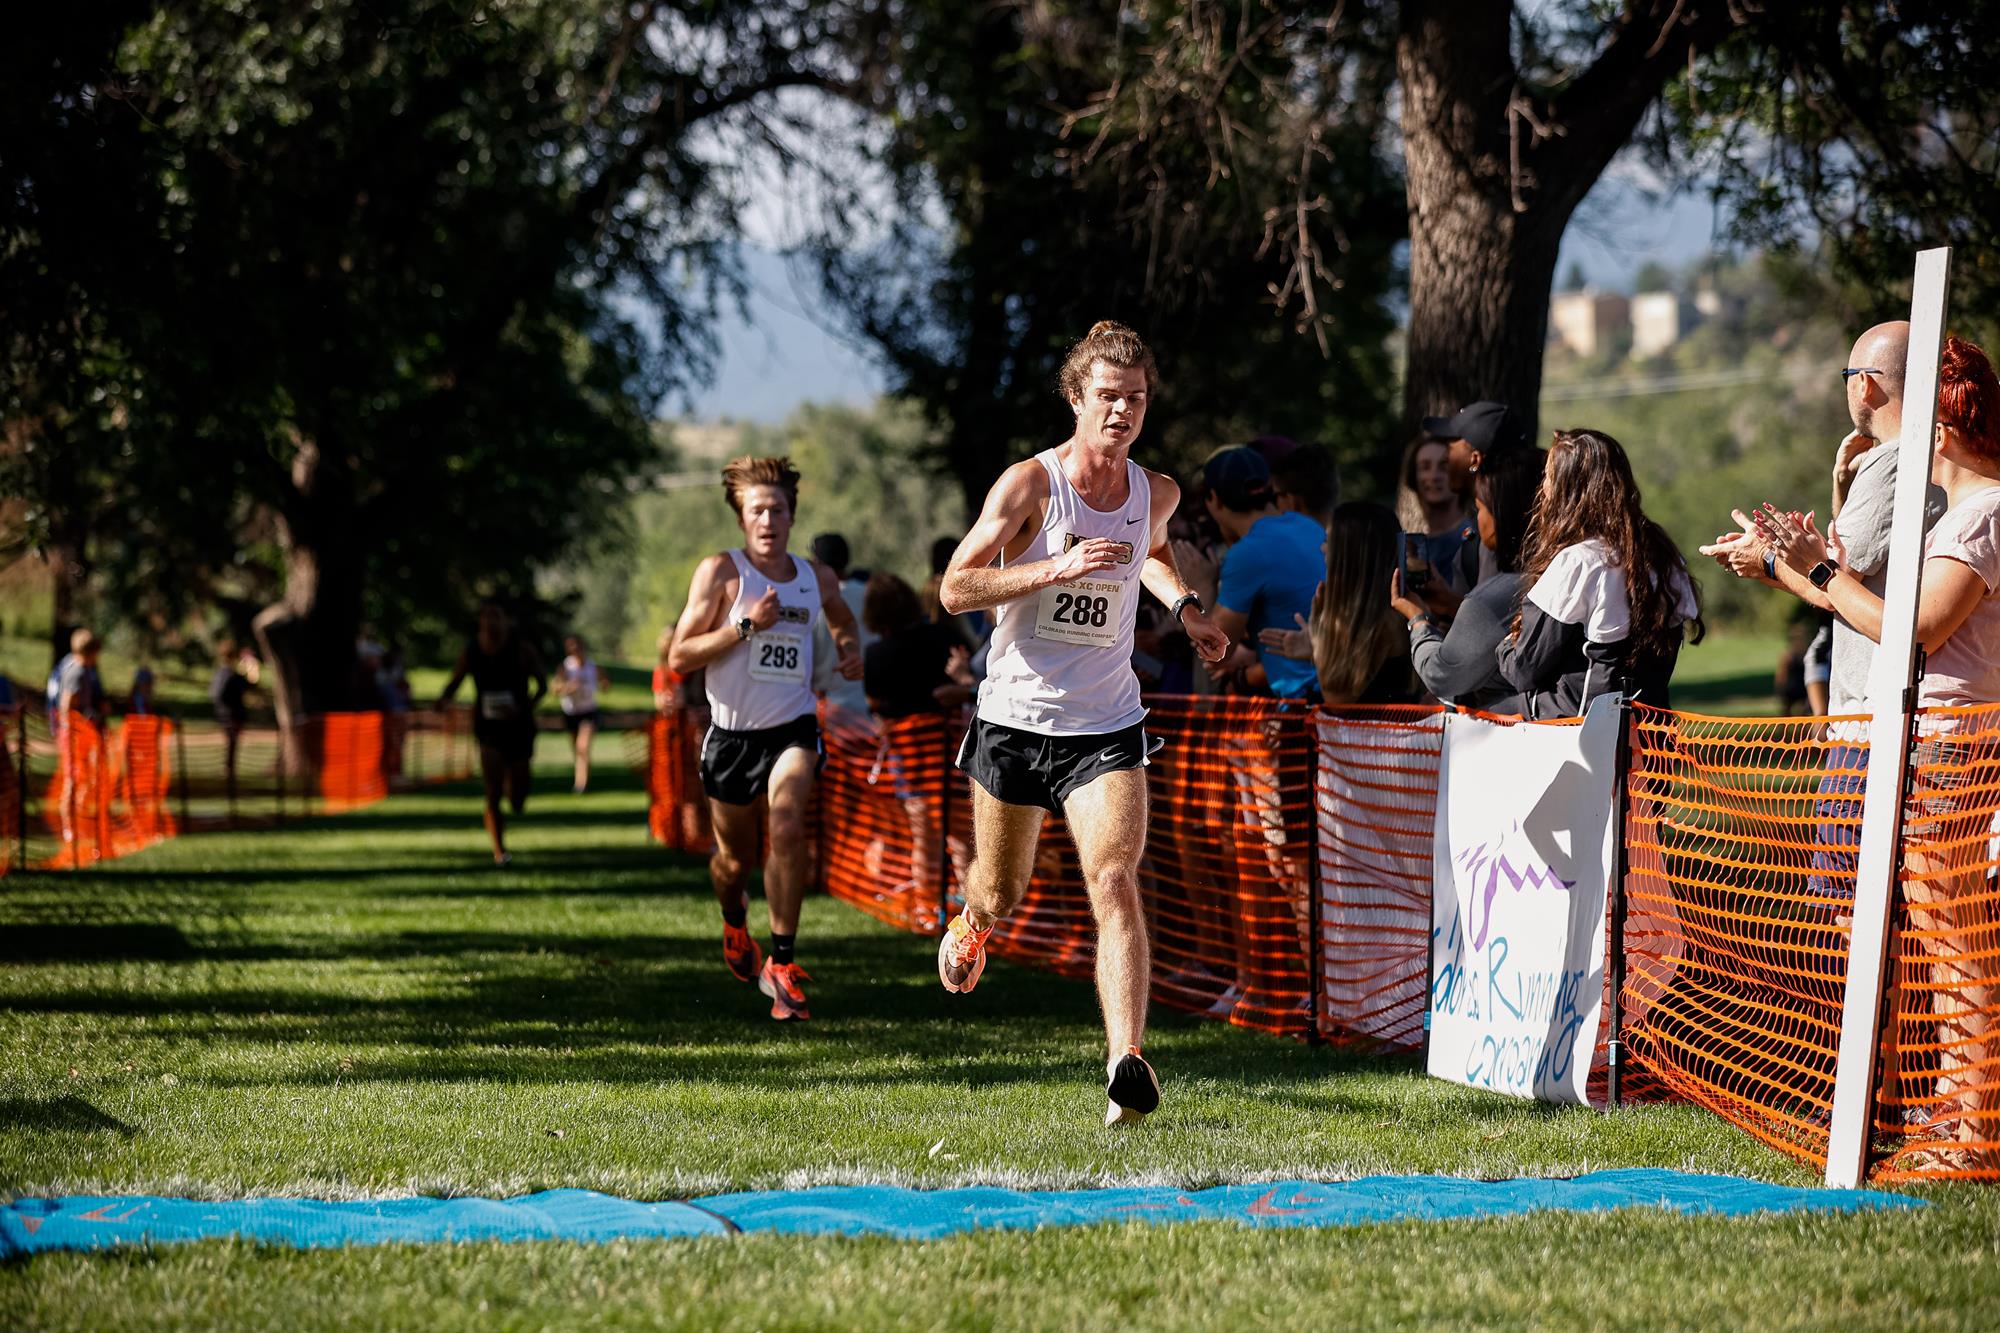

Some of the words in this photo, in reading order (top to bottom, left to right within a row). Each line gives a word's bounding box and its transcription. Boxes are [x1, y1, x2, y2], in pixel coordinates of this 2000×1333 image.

[1079, 582, 1093, 591] XC
[1095, 583, 1120, 593] OPEN
[1052, 592, 1109, 628] 288
[760, 644, 799, 670] 293
